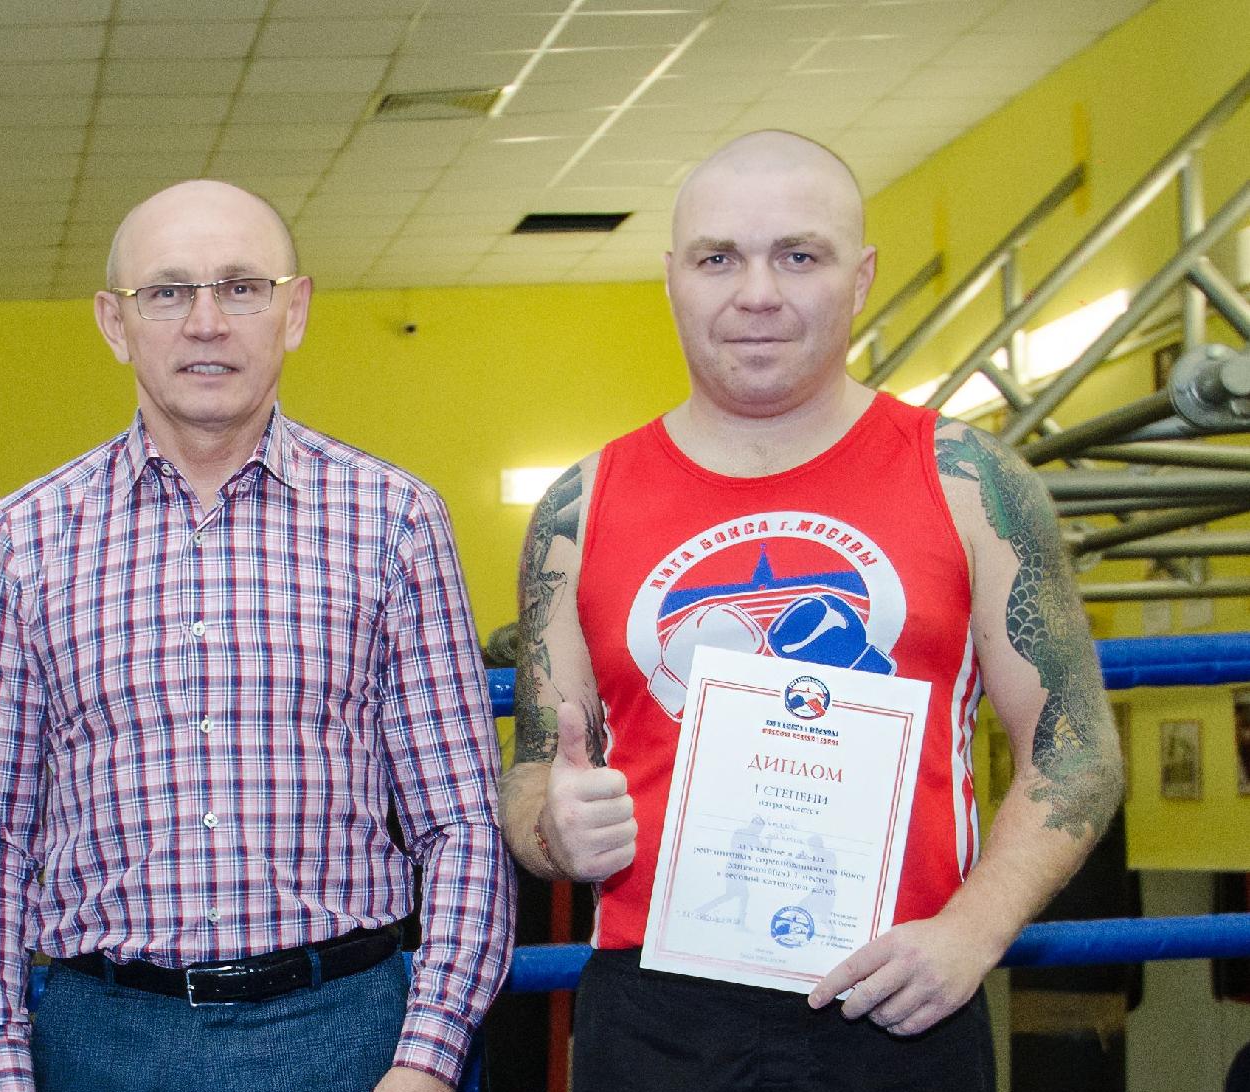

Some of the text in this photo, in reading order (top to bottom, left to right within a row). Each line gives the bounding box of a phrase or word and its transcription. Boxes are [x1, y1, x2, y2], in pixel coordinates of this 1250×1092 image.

[699, 520, 769, 551] БОКСА
[747, 753, 843, 783] ДИПЛОМ
[764, 785, 829, 805] СТЕПЕНИ
